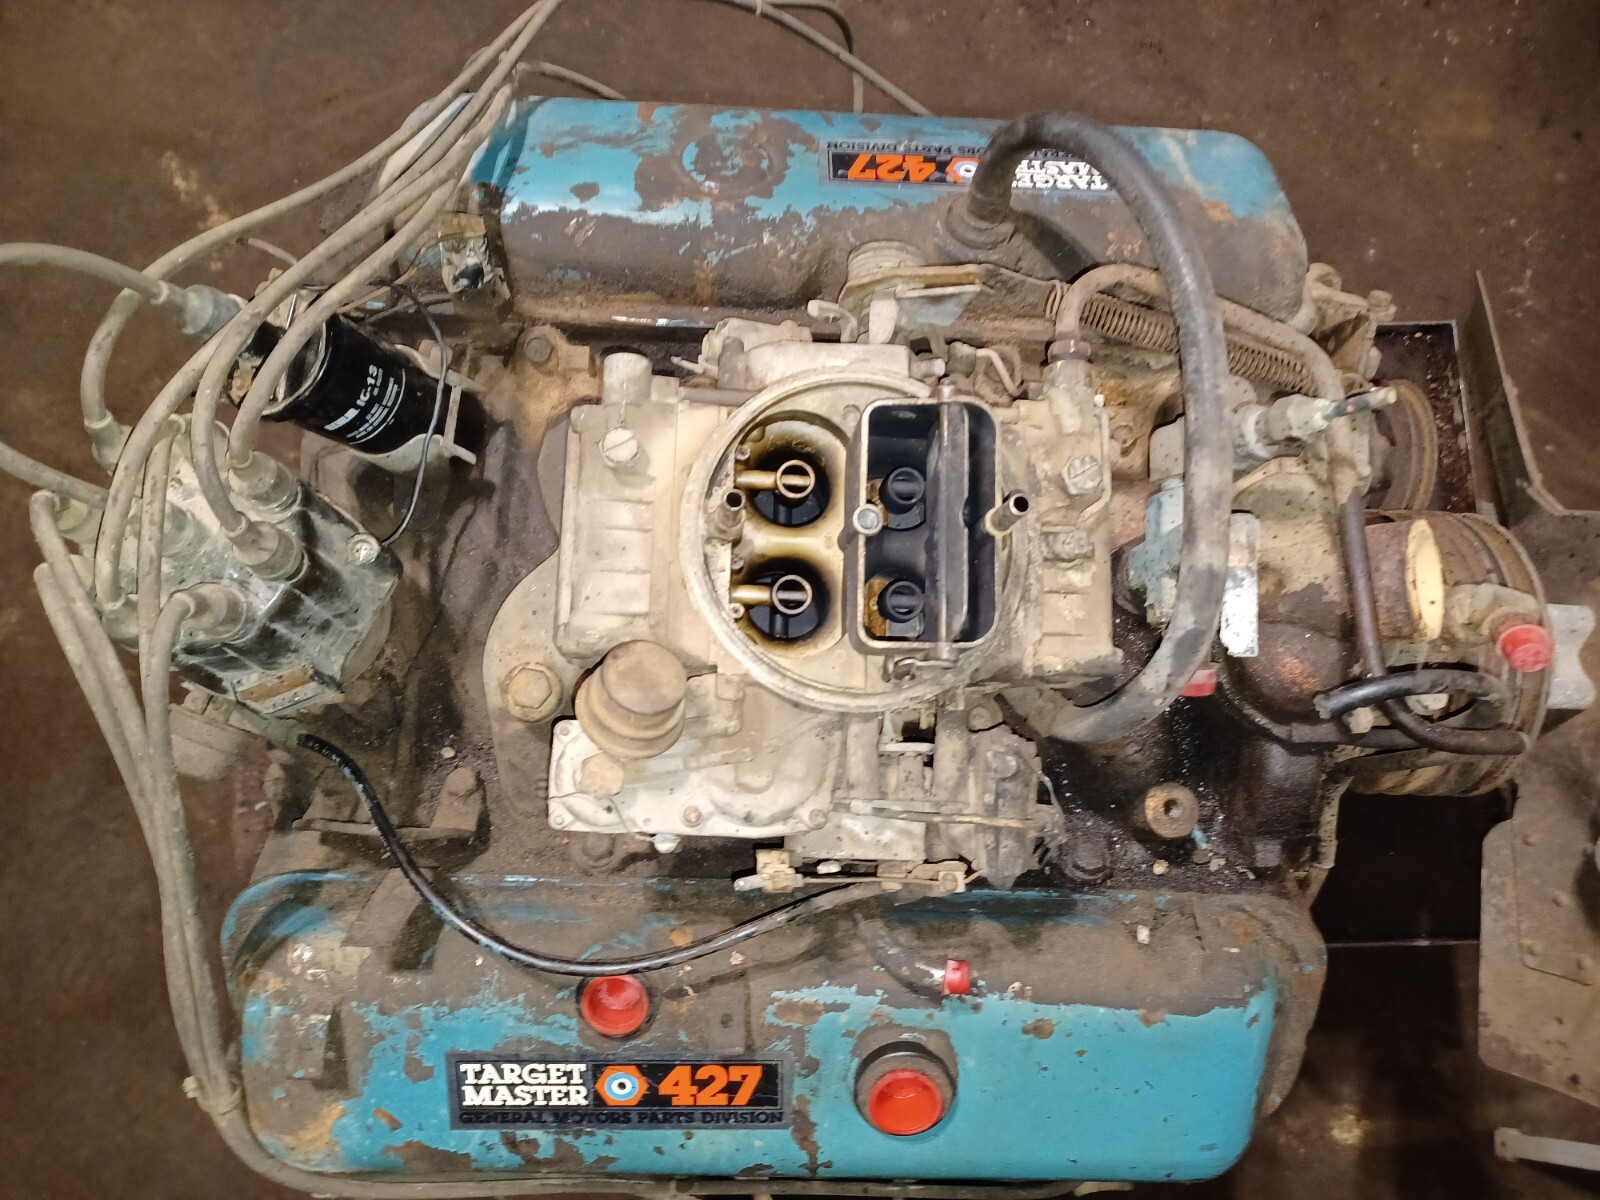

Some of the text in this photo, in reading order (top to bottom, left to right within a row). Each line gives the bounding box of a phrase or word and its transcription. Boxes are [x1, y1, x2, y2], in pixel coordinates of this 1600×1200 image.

[827, 141, 897, 152] DIVISION
[847, 153, 937, 183] 427
[1012, 174, 1108, 191] TARGE
[459, 1063, 587, 1085] TARGET
[461, 1085, 589, 1106] MASTER
[658, 1065, 764, 1106] 427
[459, 1112, 784, 1123] GENERAL MOTORS PARTS DIVISION
